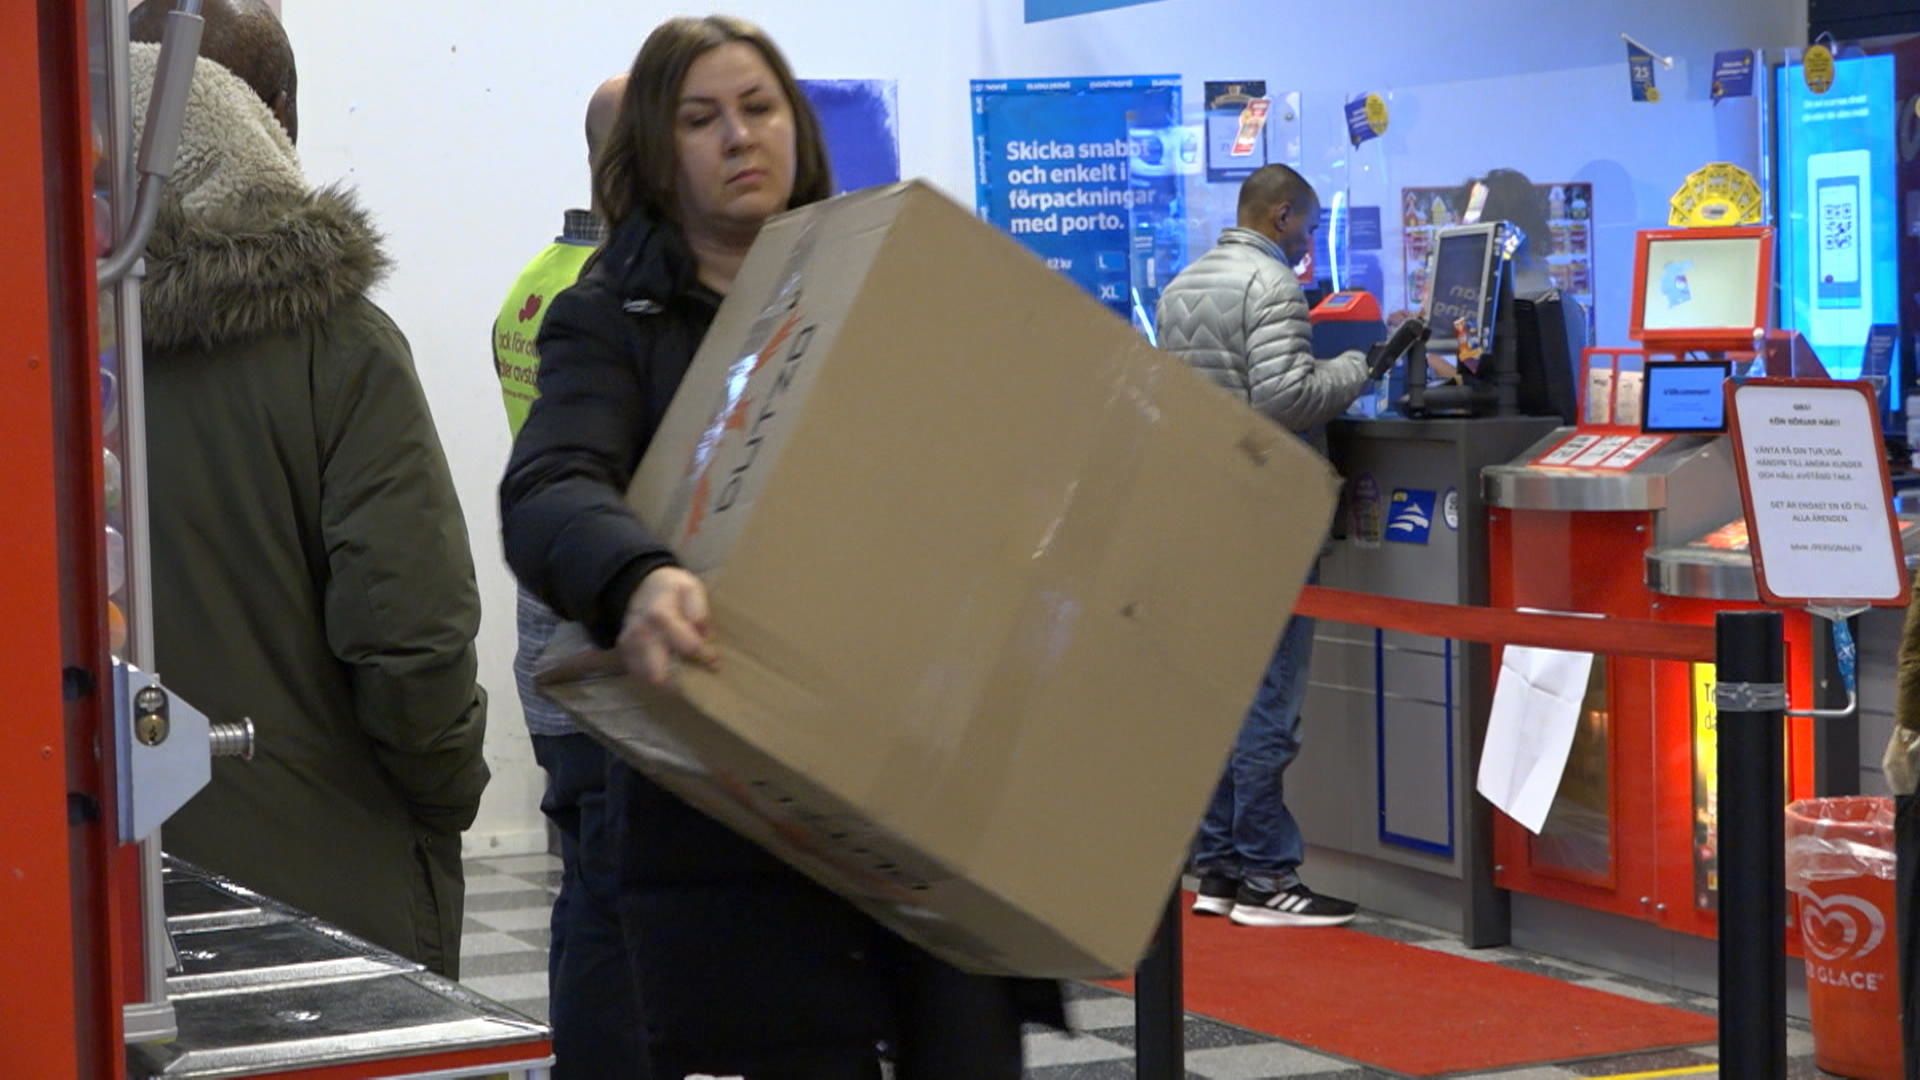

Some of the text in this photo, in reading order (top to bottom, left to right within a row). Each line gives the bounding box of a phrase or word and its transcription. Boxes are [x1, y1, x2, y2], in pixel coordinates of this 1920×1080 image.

[1006, 138, 1150, 160] Skicka snabbt
[1008, 162, 1127, 184] och enkelt i
[1009, 186, 1156, 211] förpackningar
[1011, 213, 1058, 234] med
[1062, 212, 1125, 236] porto.
[1099, 256, 1108, 269] L
[1102, 285, 1119, 299] XL
[1754, 445, 1779, 455] VÄNTA
[1781, 445, 1792, 455] PÅ
[1793, 447, 1807, 455] DIN
[1792, 514, 1811, 523] ALLA
